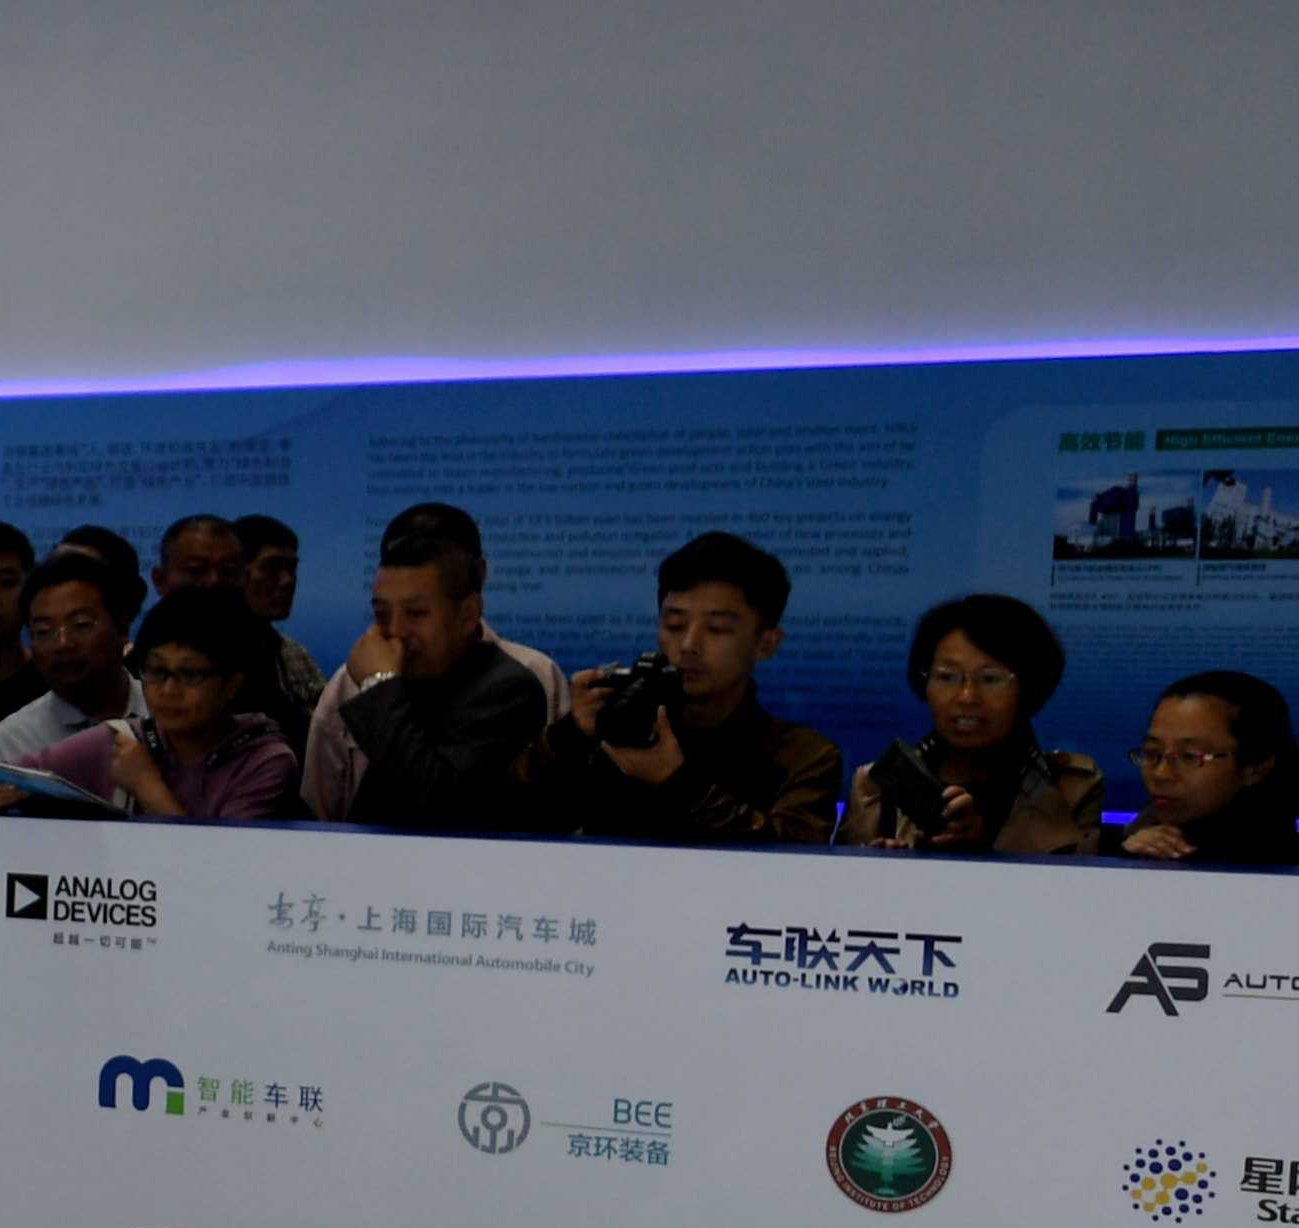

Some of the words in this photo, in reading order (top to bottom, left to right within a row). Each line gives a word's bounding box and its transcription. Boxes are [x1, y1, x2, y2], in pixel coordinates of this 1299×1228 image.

[54, 875, 158, 903] ANALOG
[53, 900, 158, 928] DEVICES
[266, 939, 313, 960] Anting
[315, 943, 380, 964] Shanghai
[381, 948, 474, 968] International
[475, 954, 562, 974] Automobile
[563, 959, 595, 979] City
[725, 923, 963, 977] 车联天下
[724, 967, 860, 994] AUTO-LINK
[197, 1075, 324, 1113] 智能车联
[612, 1097, 673, 1131] BEE
[566, 1132, 671, 1167] 京环装备
